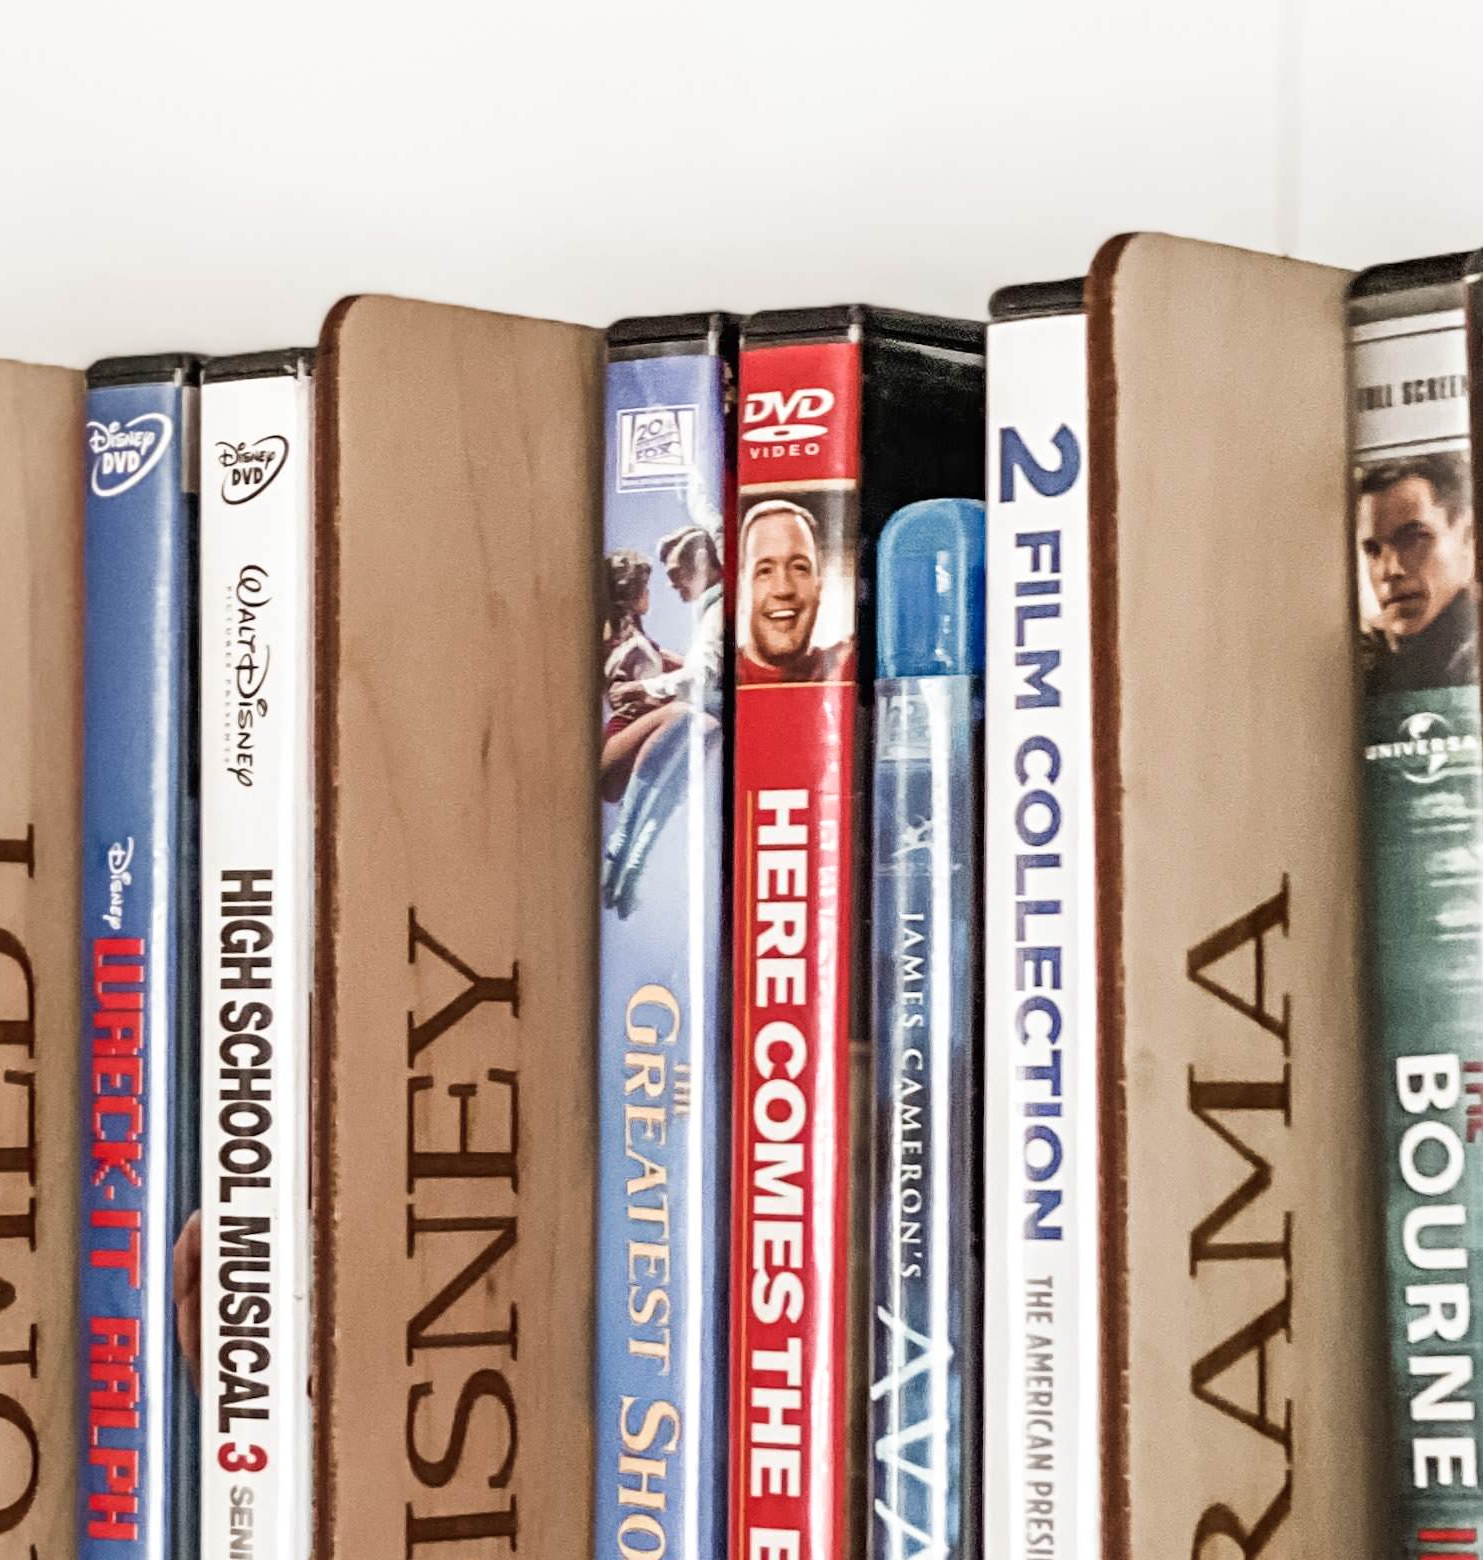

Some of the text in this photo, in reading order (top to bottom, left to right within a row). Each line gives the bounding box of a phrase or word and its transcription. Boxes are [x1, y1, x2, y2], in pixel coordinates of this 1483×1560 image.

[101, 450, 140, 474] DVD
[232, 468, 263, 486] DVD
[742, 388, 835, 424] DVD
[750, 443, 819, 460] VIDEO
[755, 788, 809, 1009] HERE
[998, 423, 1081, 1242] 2 FILM COLLECTION
[216, 869, 273, 1474] HIGH SCHOOL MUSICAL 3
[624, 982, 682, 1378] GREATEST
[751, 1020, 808, 1325] COMES
[898, 911, 924, 1280] JAMES CAMERON'S
[1025, 1275, 1054, 1325] THE
[1396, 1053, 1479, 1490] BOURNE
[87, 1316, 140, 1542] RALPH
[748, 1337, 803, 1498] THE
[1025, 1333, 1054, 1471] AMERICAN
